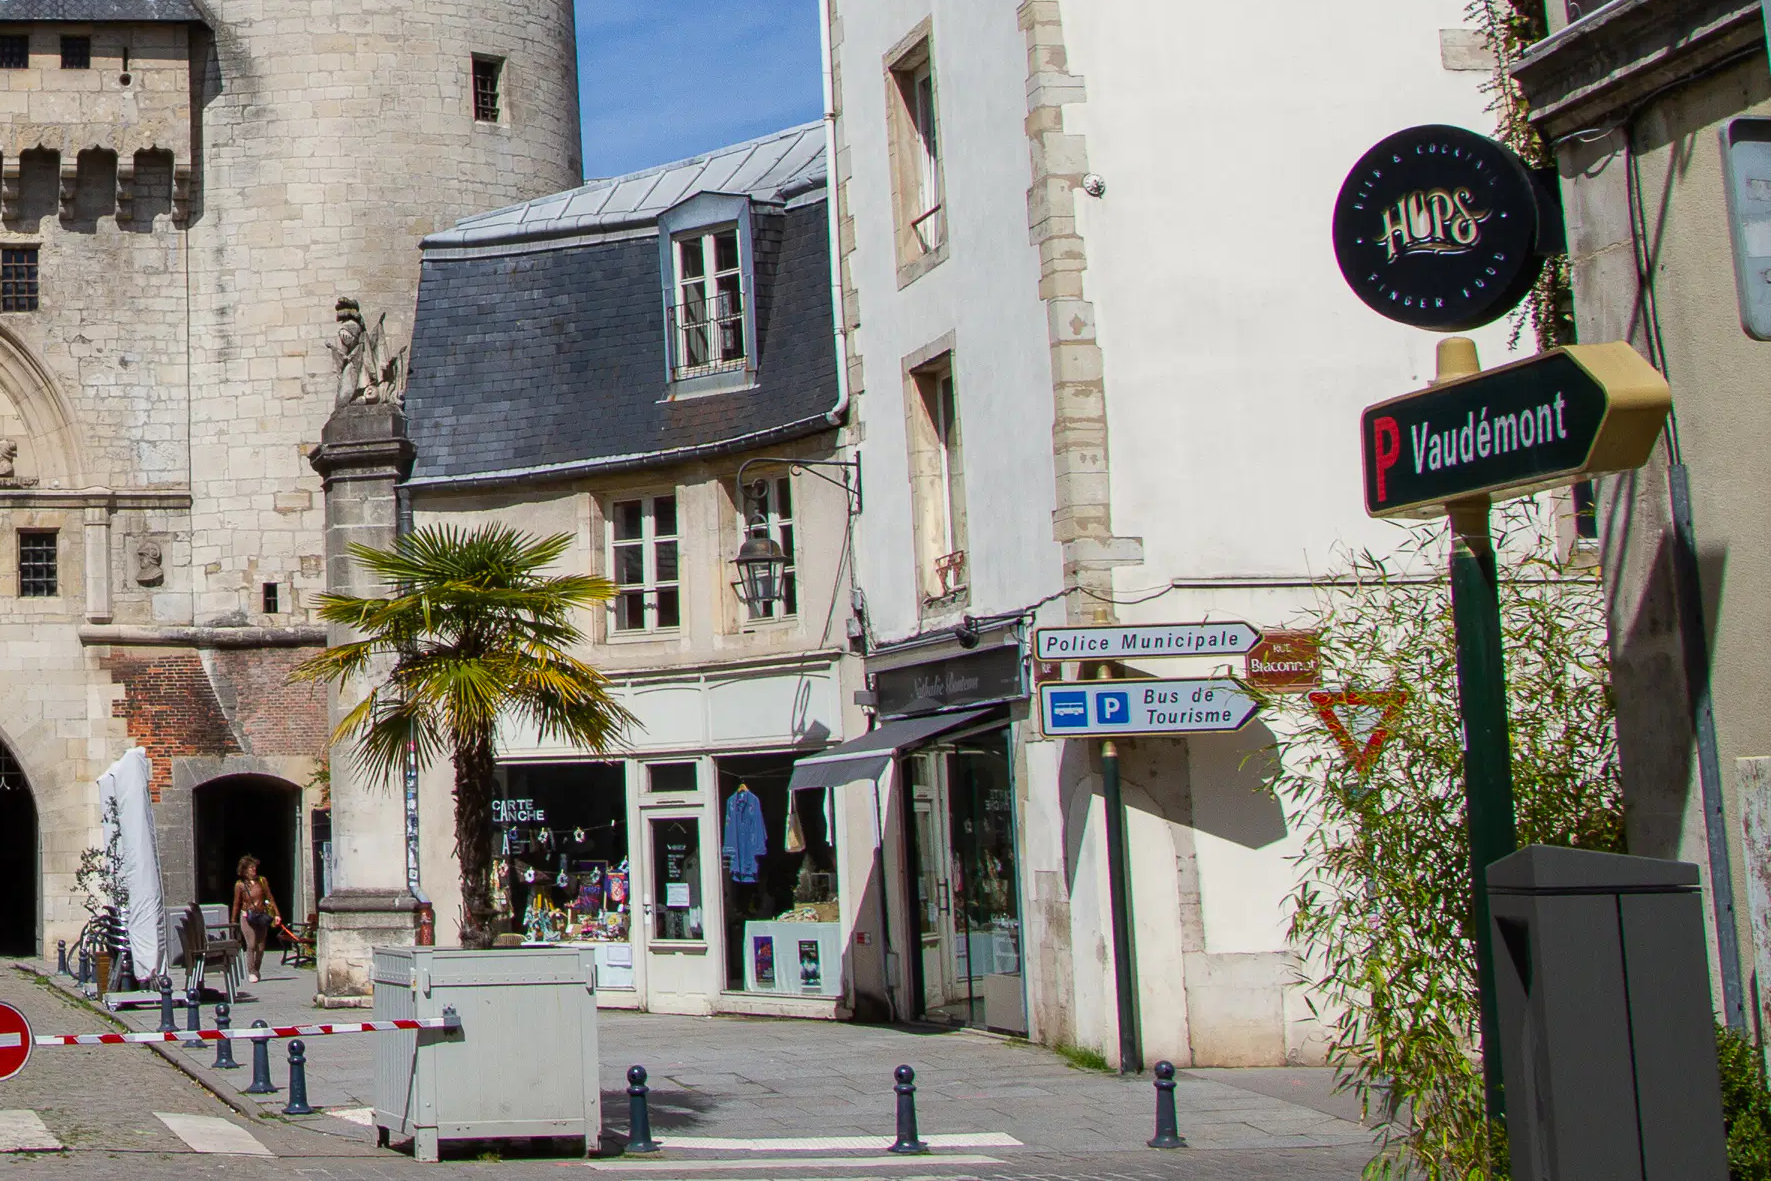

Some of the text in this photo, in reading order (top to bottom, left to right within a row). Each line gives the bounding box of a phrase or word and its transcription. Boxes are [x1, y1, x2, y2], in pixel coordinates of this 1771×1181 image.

[1367, 252, 1506, 309] FINGER FOOD
[1374, 391, 1568, 502] P Vaudémont
[1046, 631, 1239, 652] Police Municipale
[1104, 687, 1214, 719] P Bus de
[1146, 709, 1232, 725] Tourisme
[492, 799, 533, 813] CARTE
